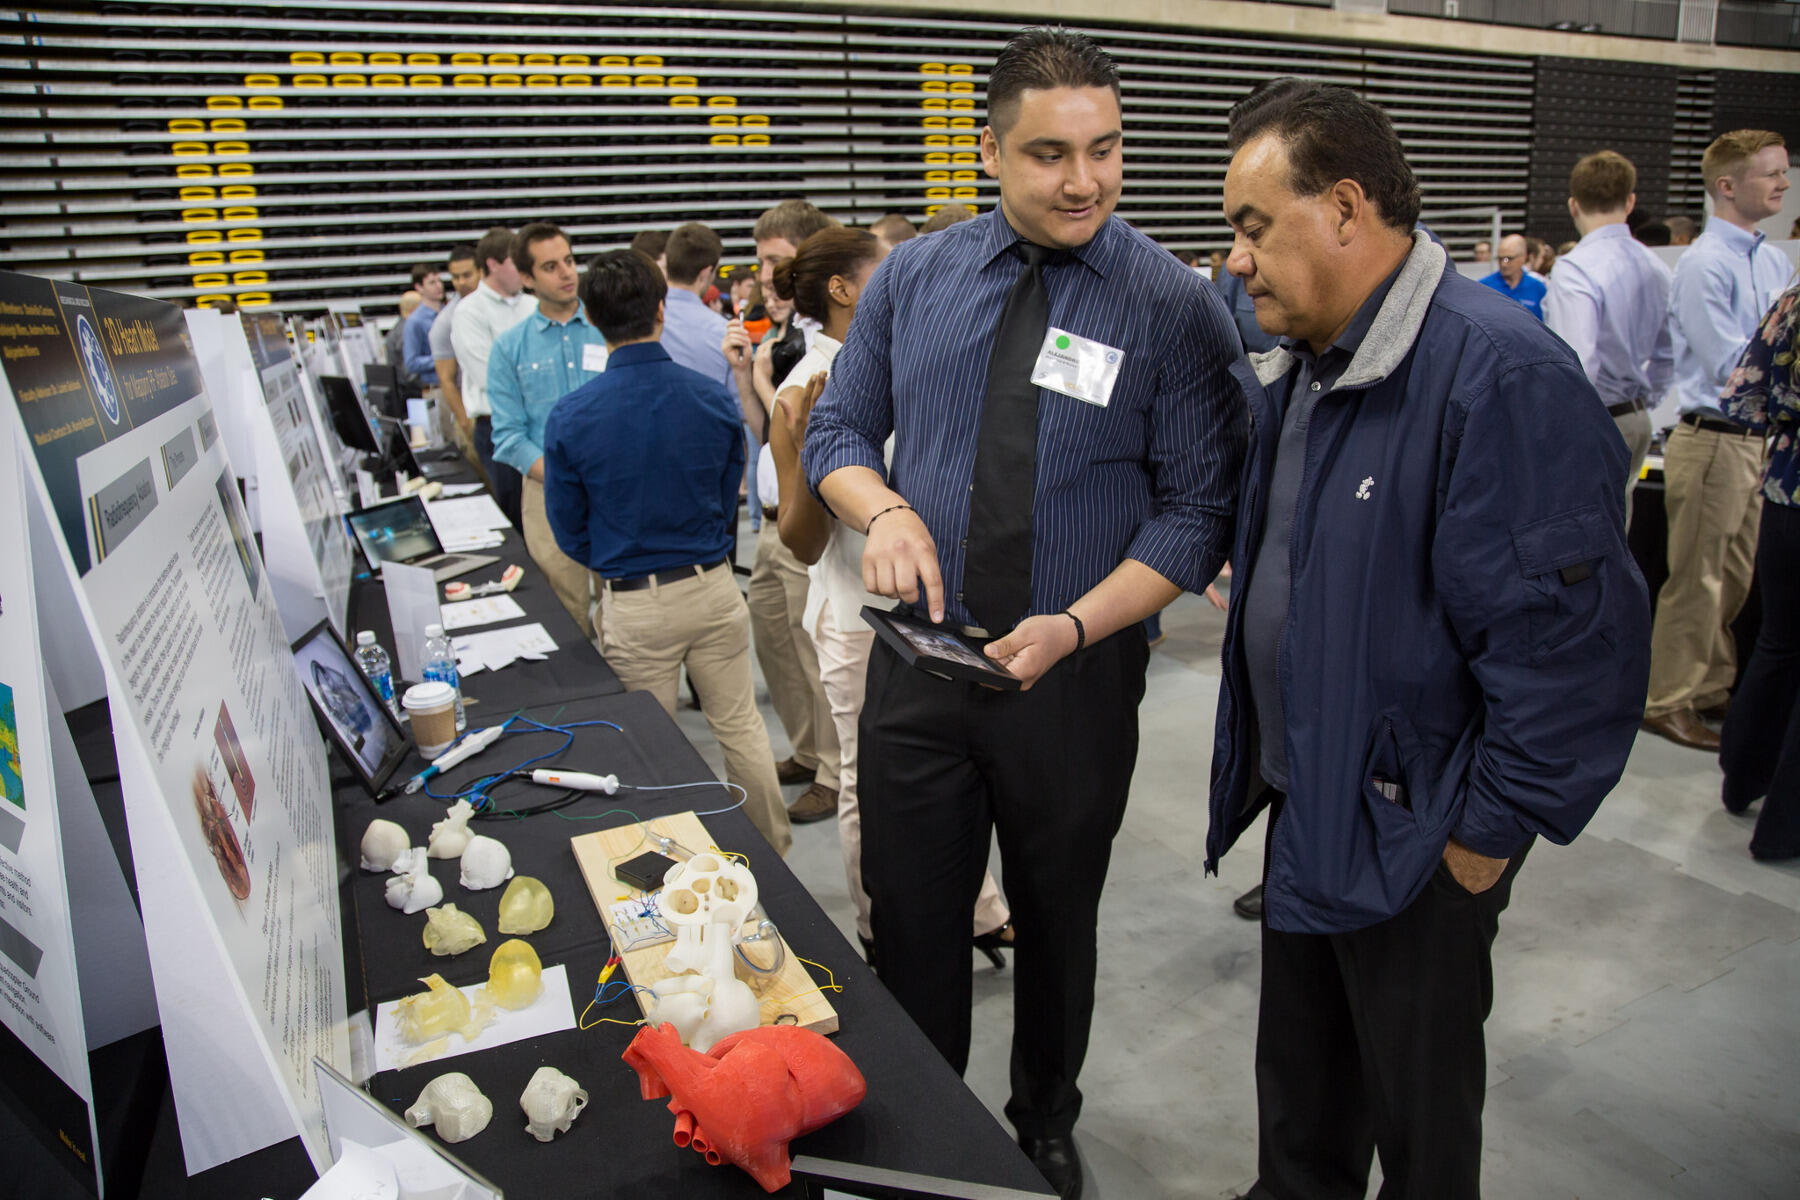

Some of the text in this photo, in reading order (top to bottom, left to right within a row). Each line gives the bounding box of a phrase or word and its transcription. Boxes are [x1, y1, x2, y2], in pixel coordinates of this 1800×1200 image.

[103, 317, 123, 355] 3D
[114, 318, 143, 354] Heart
[134, 319, 160, 352] Model
